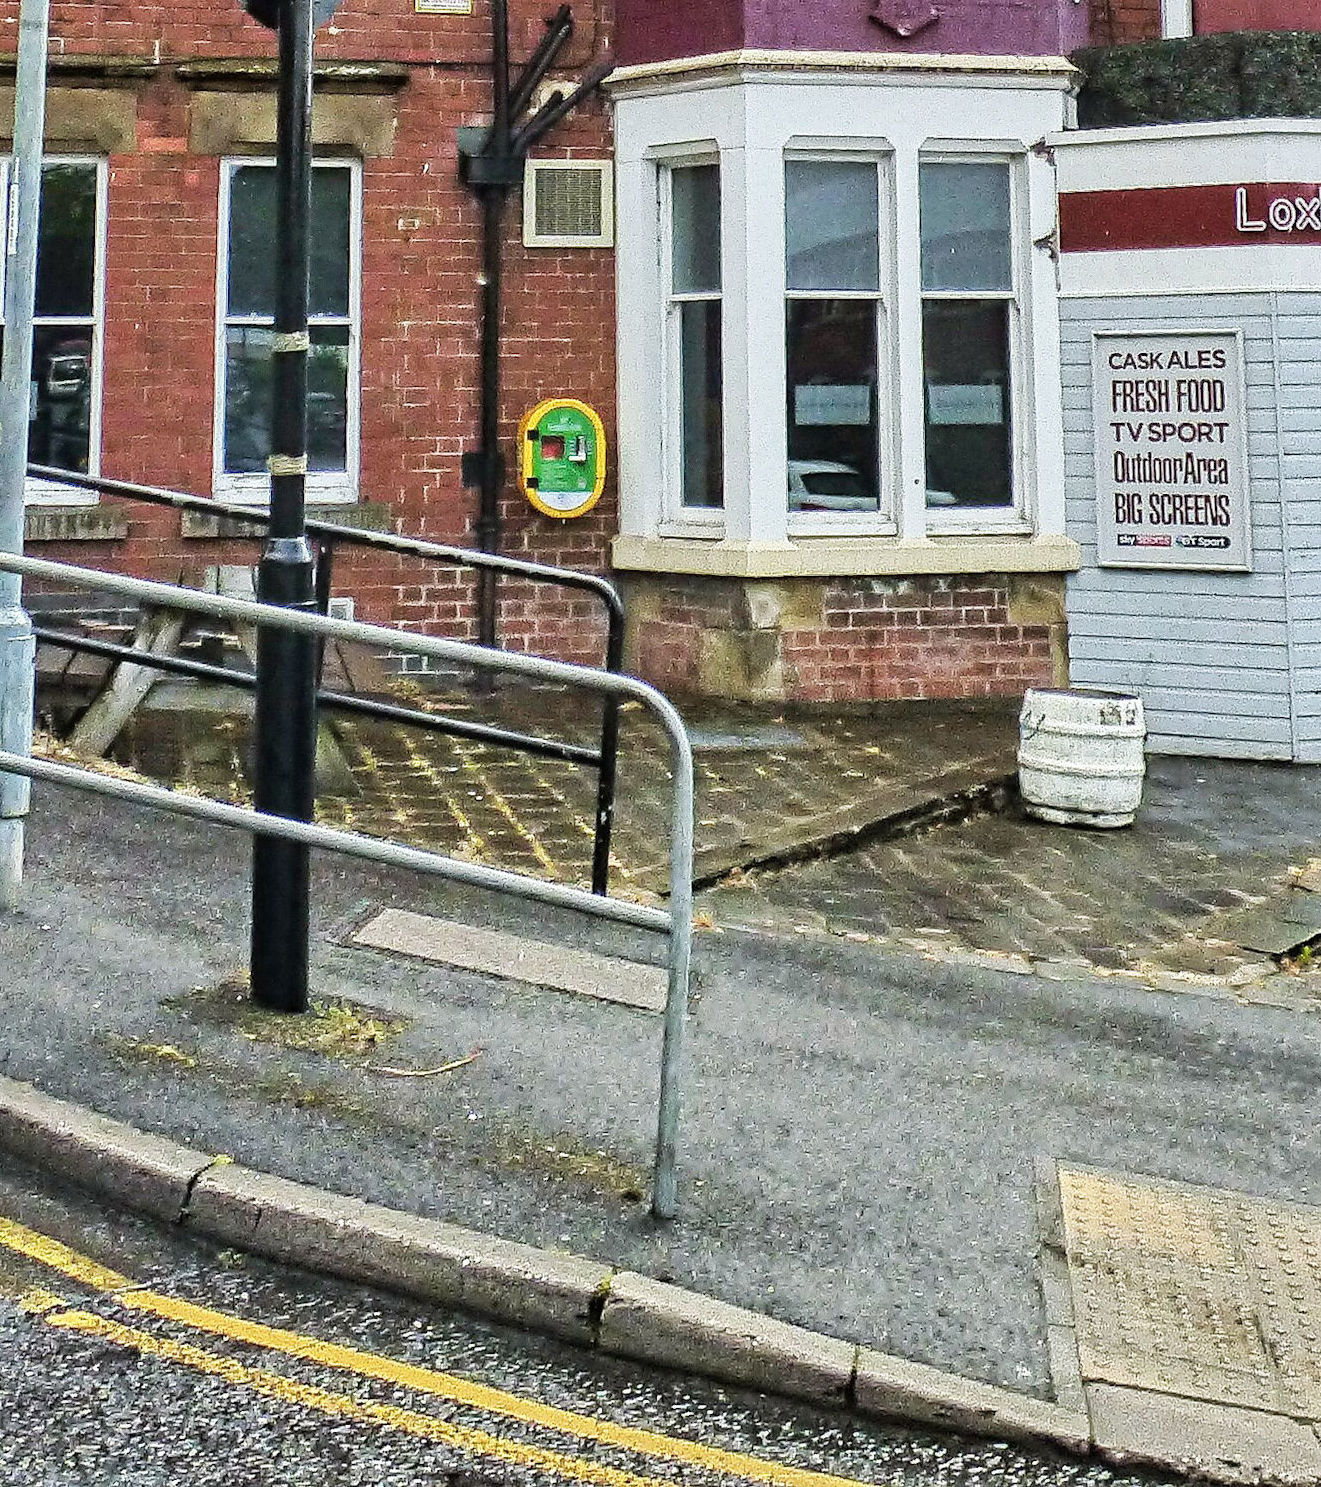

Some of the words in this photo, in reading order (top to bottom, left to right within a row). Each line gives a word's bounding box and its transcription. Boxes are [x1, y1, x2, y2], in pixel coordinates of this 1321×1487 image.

[1108, 352, 1164, 370] CASK
[1167, 349, 1227, 370] ALES
[1111, 379, 1170, 413] FRESH
[1176, 379, 1226, 413] FOOD
[1109, 422, 1144, 443] TV
[1147, 422, 1230, 444] SPORT
[1113, 450, 1183, 484] Outdoor
[1183, 451, 1229, 485] Area
[1114, 492, 1143, 525] BIG
[1148, 493, 1231, 527] SCREENS
